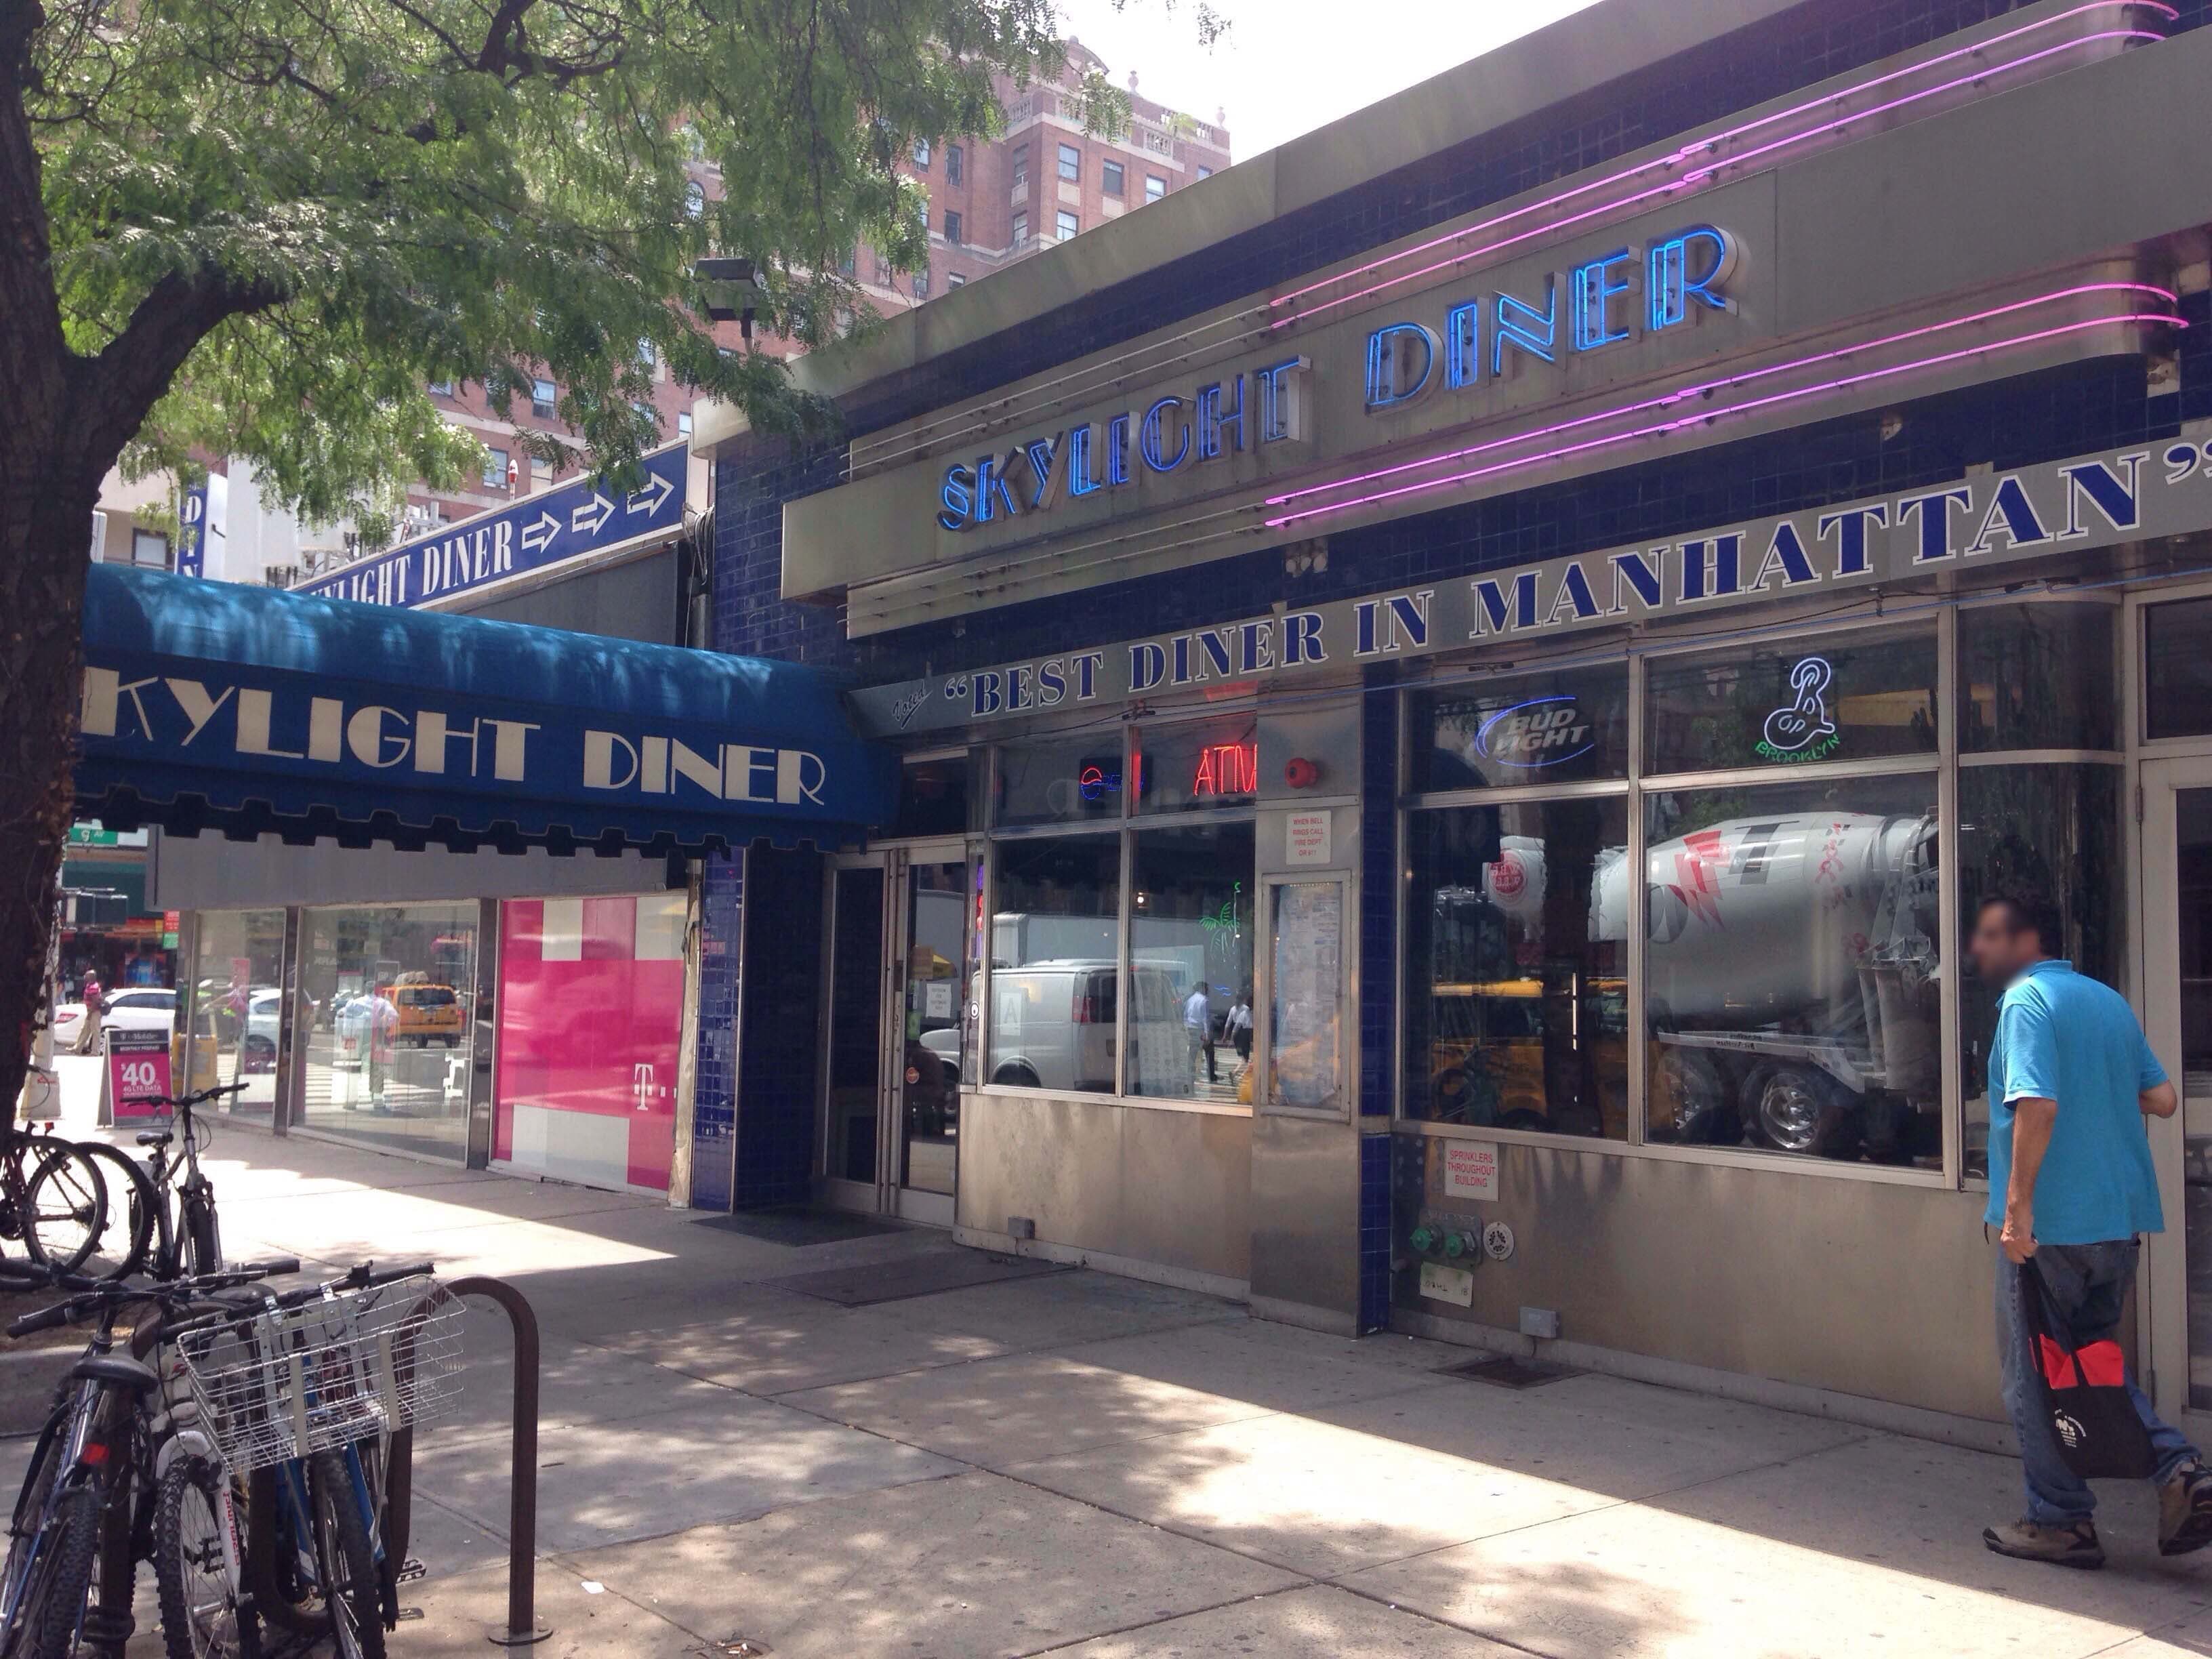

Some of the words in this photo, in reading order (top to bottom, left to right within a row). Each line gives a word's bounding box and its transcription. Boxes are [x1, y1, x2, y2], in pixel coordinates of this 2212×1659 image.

[937, 355, 1311, 531] SKYLIGHT
[1365, 224, 1739, 415] DINER
[310, 555, 411, 606] LIGHT
[422, 520, 512, 596] DINER
[1128, 612, 1329, 693] DINER
[1353, 590, 1435, 658] IN
[1507, 708, 1576, 735] BUD
[81, 666, 541, 782] KYLIGHT
[583, 730, 825, 806] DINER
[1755, 733, 1841, 764] BROOKLYN
[1292, 817, 1309, 825] WHEN
[1309, 817, 1324, 825] BELL
[81, 829, 91, 842] 9
[1448, 1162, 1496, 1176] THROUGHOUT
[1450, 1149, 1493, 1164] SPRINKLERS
[1455, 1174, 1488, 1187] BUILDING
